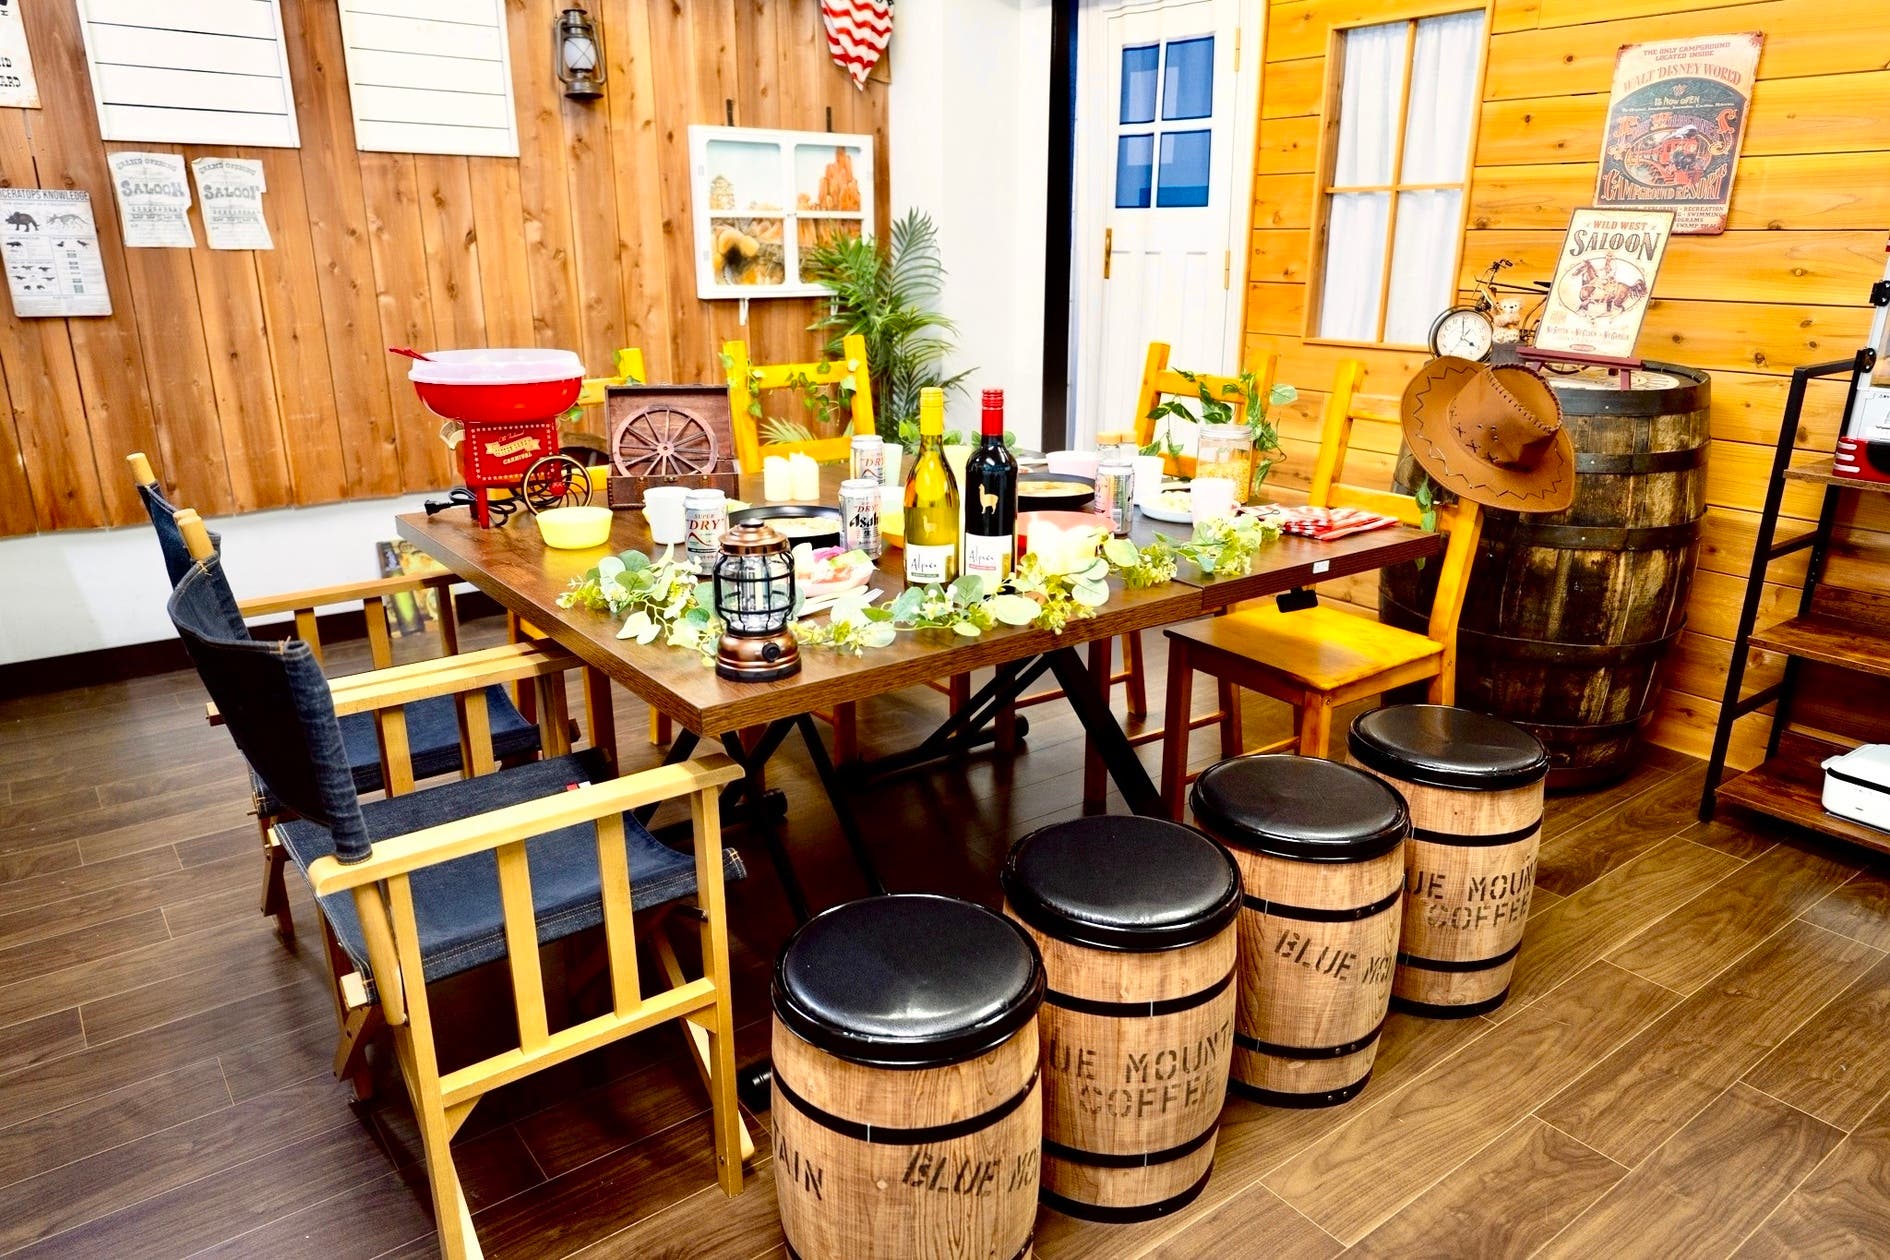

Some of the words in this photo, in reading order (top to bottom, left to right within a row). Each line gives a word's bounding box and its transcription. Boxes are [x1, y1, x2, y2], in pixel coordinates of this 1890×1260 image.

[1643, 49, 1658, 57] THE
[1679, 42, 1731, 53] CAMPGROUND
[1655, 53, 1687, 61] LOCATED
[1689, 50, 1715, 58] INSIDE
[1623, 69, 1656, 92] WALT
[1657, 62, 1701, 77] DISNEY
[1703, 63, 1741, 86] WORLD
[43, 190, 88, 201] KNOWLEDGE
[120, 179, 186, 197] SALOON
[1593, 220, 1617, 230] WILD
[1620, 220, 1648, 231] WEST
[1569, 229, 1662, 261] SALOON
[1427, 892, 1530, 931] COFFEE
[1274, 929, 1357, 981] BLUE
[1079, 1072, 1216, 1118] COFFEE
[901, 1152, 1002, 1197] BLUE
